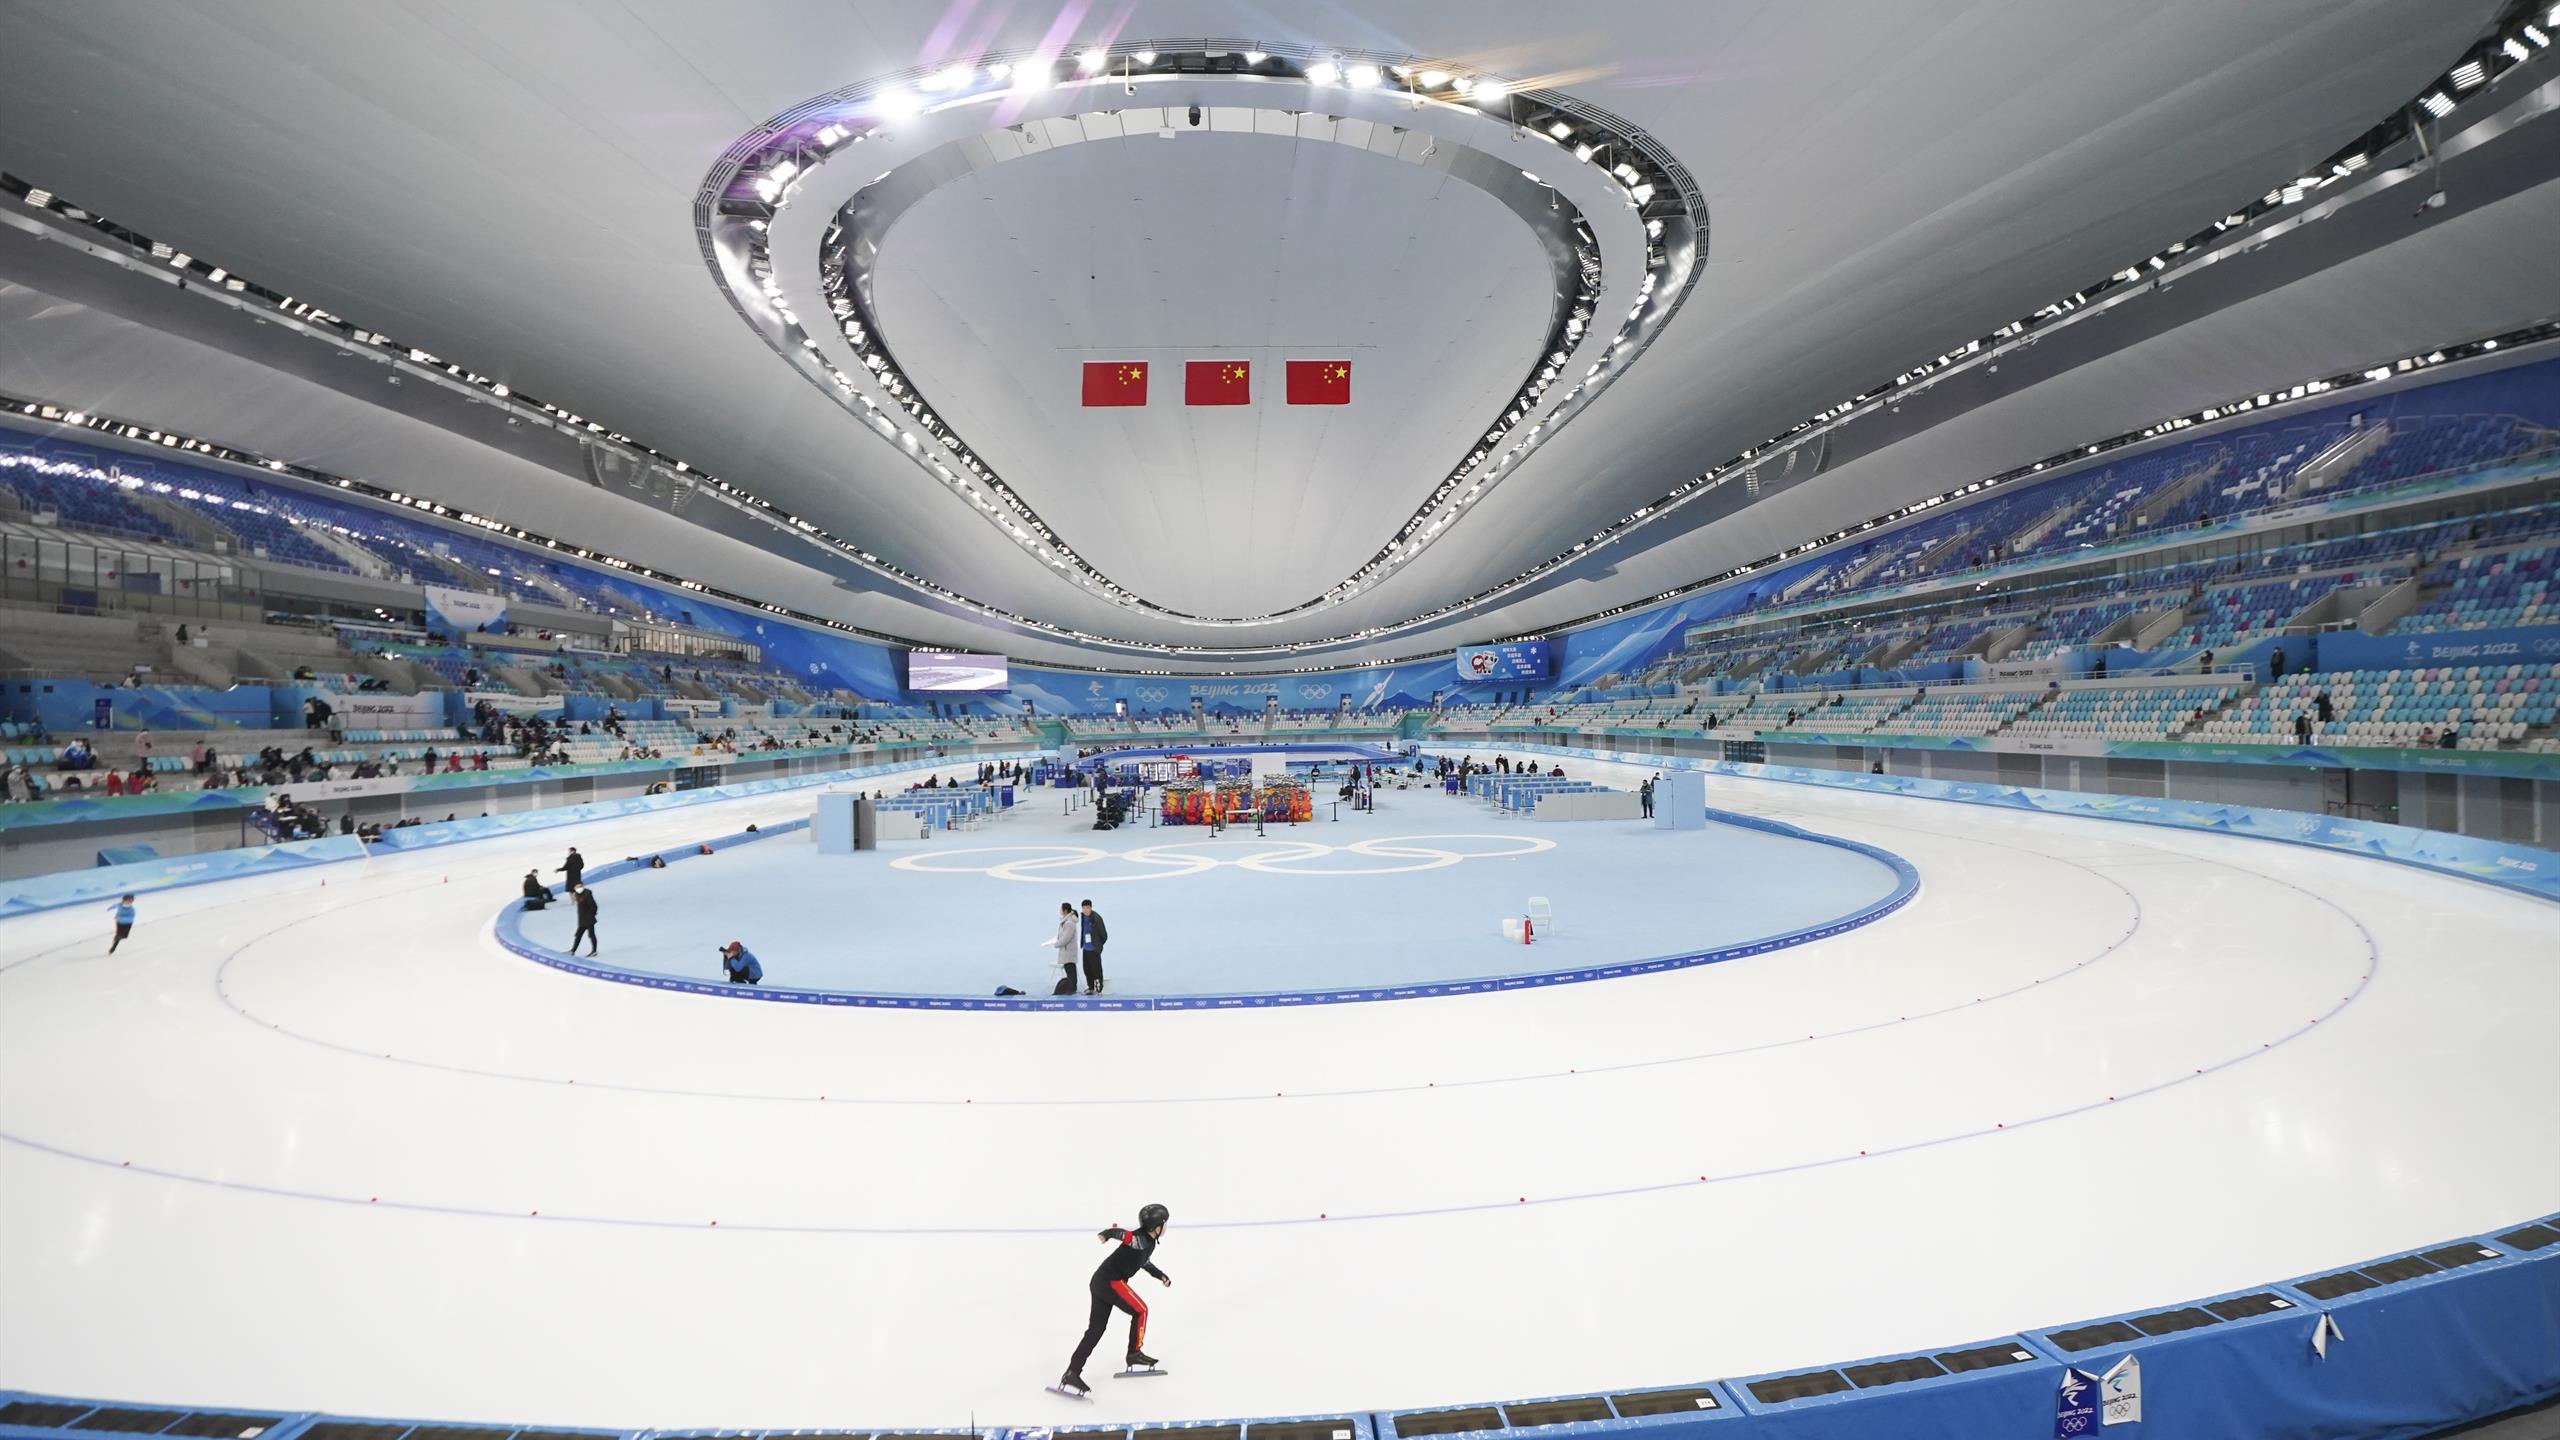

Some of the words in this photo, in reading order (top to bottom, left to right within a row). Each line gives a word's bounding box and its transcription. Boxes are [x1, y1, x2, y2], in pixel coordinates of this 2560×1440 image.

[2432, 645, 2478, 660] BEIJING
[2483, 643, 2519, 655] 2022
[1190, 685, 1238, 698] BEIJING
[1243, 683, 1279, 694] 2022
